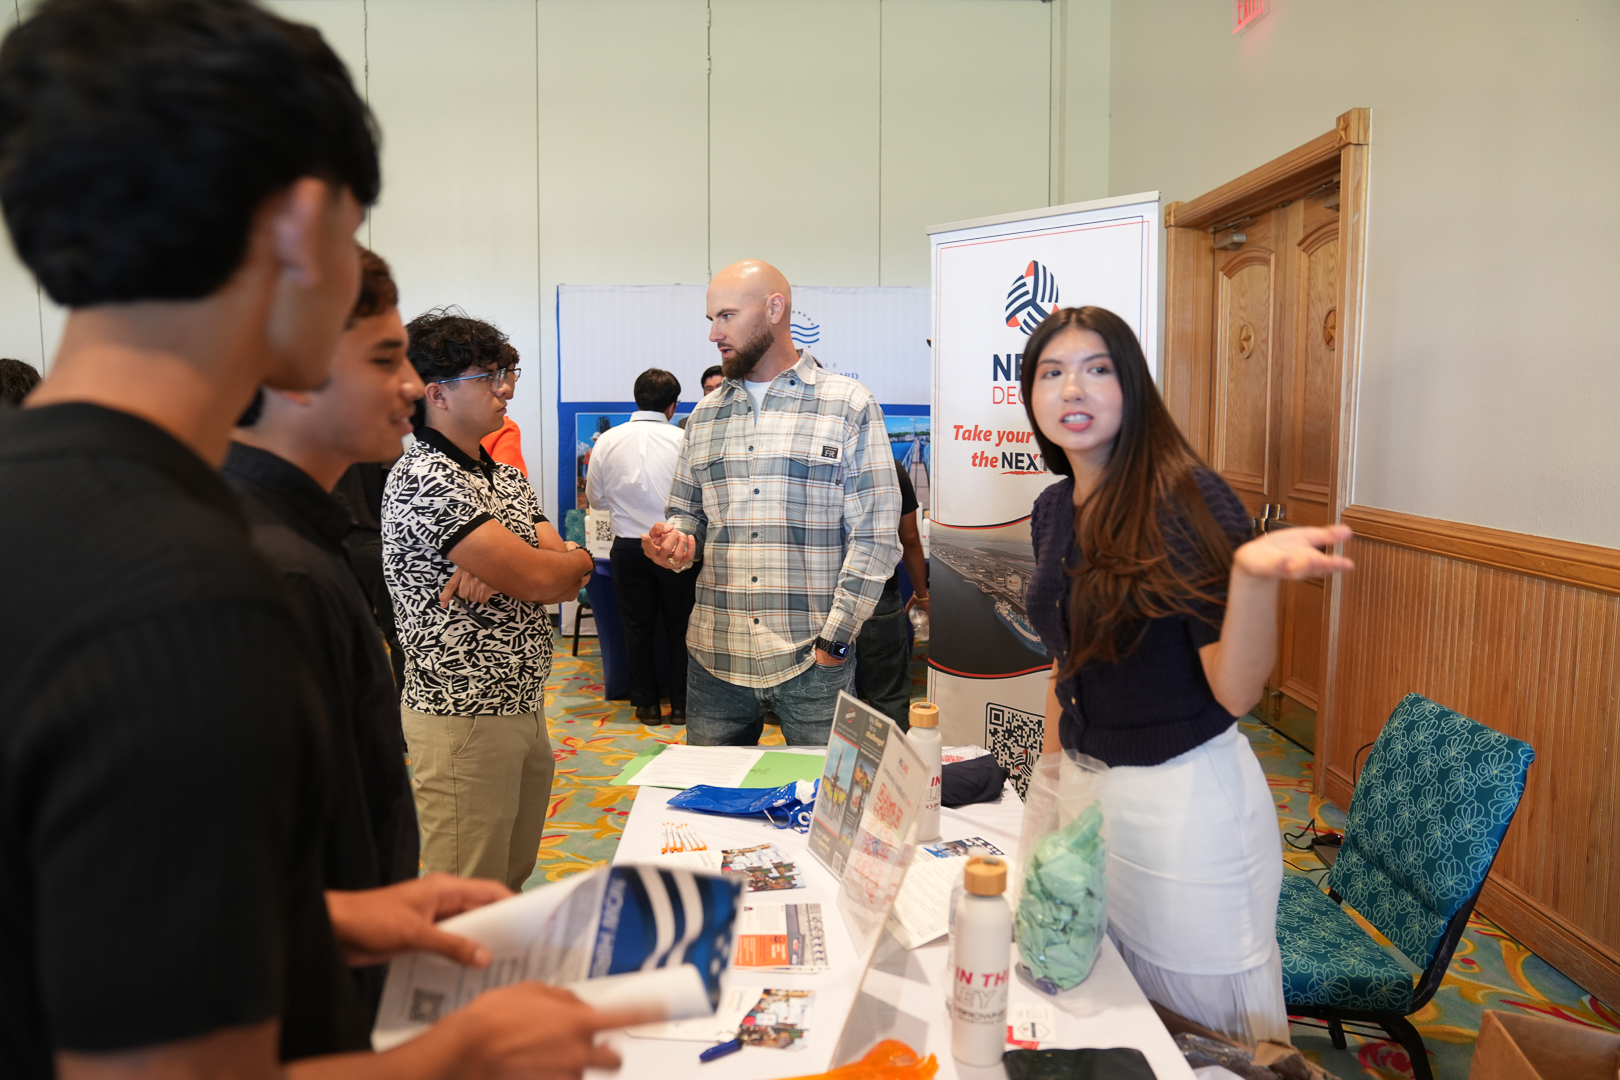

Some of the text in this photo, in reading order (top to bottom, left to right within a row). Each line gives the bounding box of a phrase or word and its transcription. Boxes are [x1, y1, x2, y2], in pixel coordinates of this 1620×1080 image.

[992, 353, 1024, 382] NE
[953, 424, 1034, 447] Take your
[971, 451, 998, 469] the
[956, 966, 973, 985] IN
